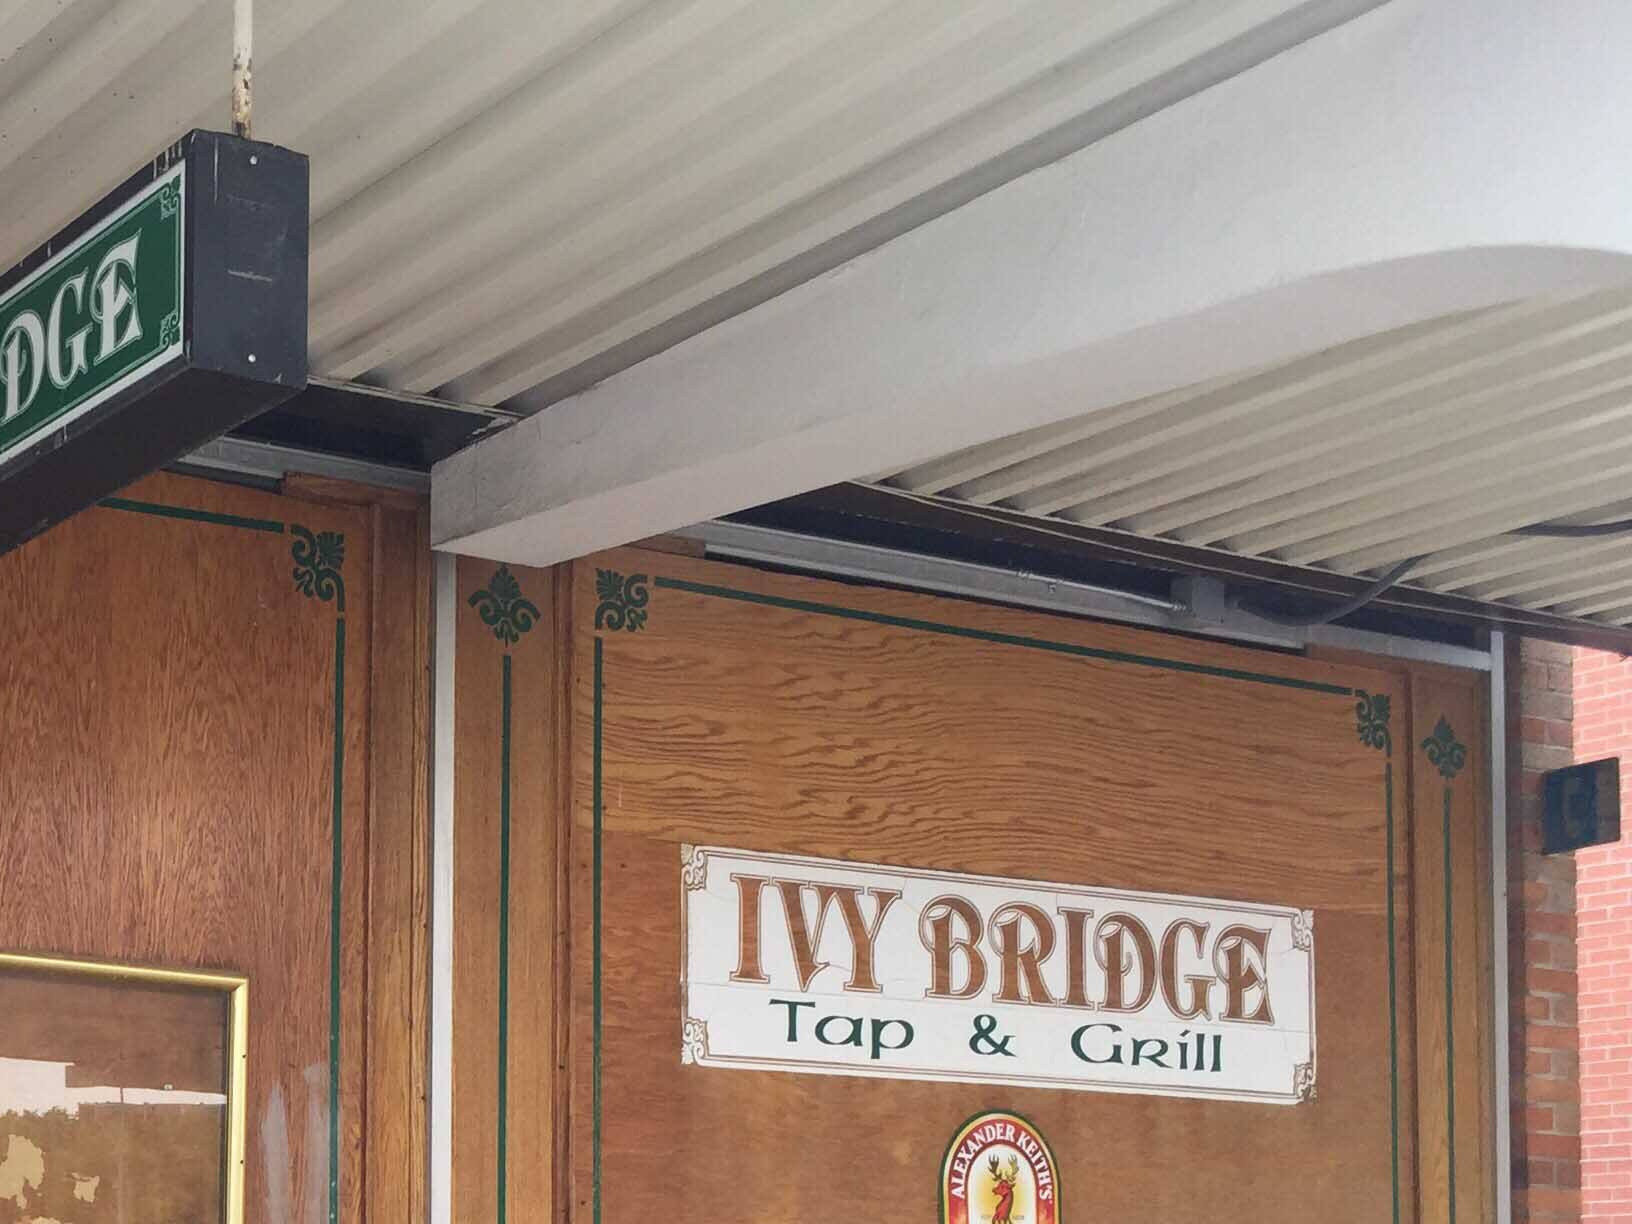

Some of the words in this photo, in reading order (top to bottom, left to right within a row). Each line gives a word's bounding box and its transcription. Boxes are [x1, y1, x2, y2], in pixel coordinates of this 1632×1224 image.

[729, 872, 903, 993] IVY
[919, 893, 1275, 1027] BRIDGE
[769, 999, 914, 1060] Tap
[969, 1014, 1017, 1057] &
[1070, 1022, 1222, 1072] Grill
[951, 1122, 1016, 1199] ALEXANDER
[1016, 1130, 1053, 1201] KEITH'S
